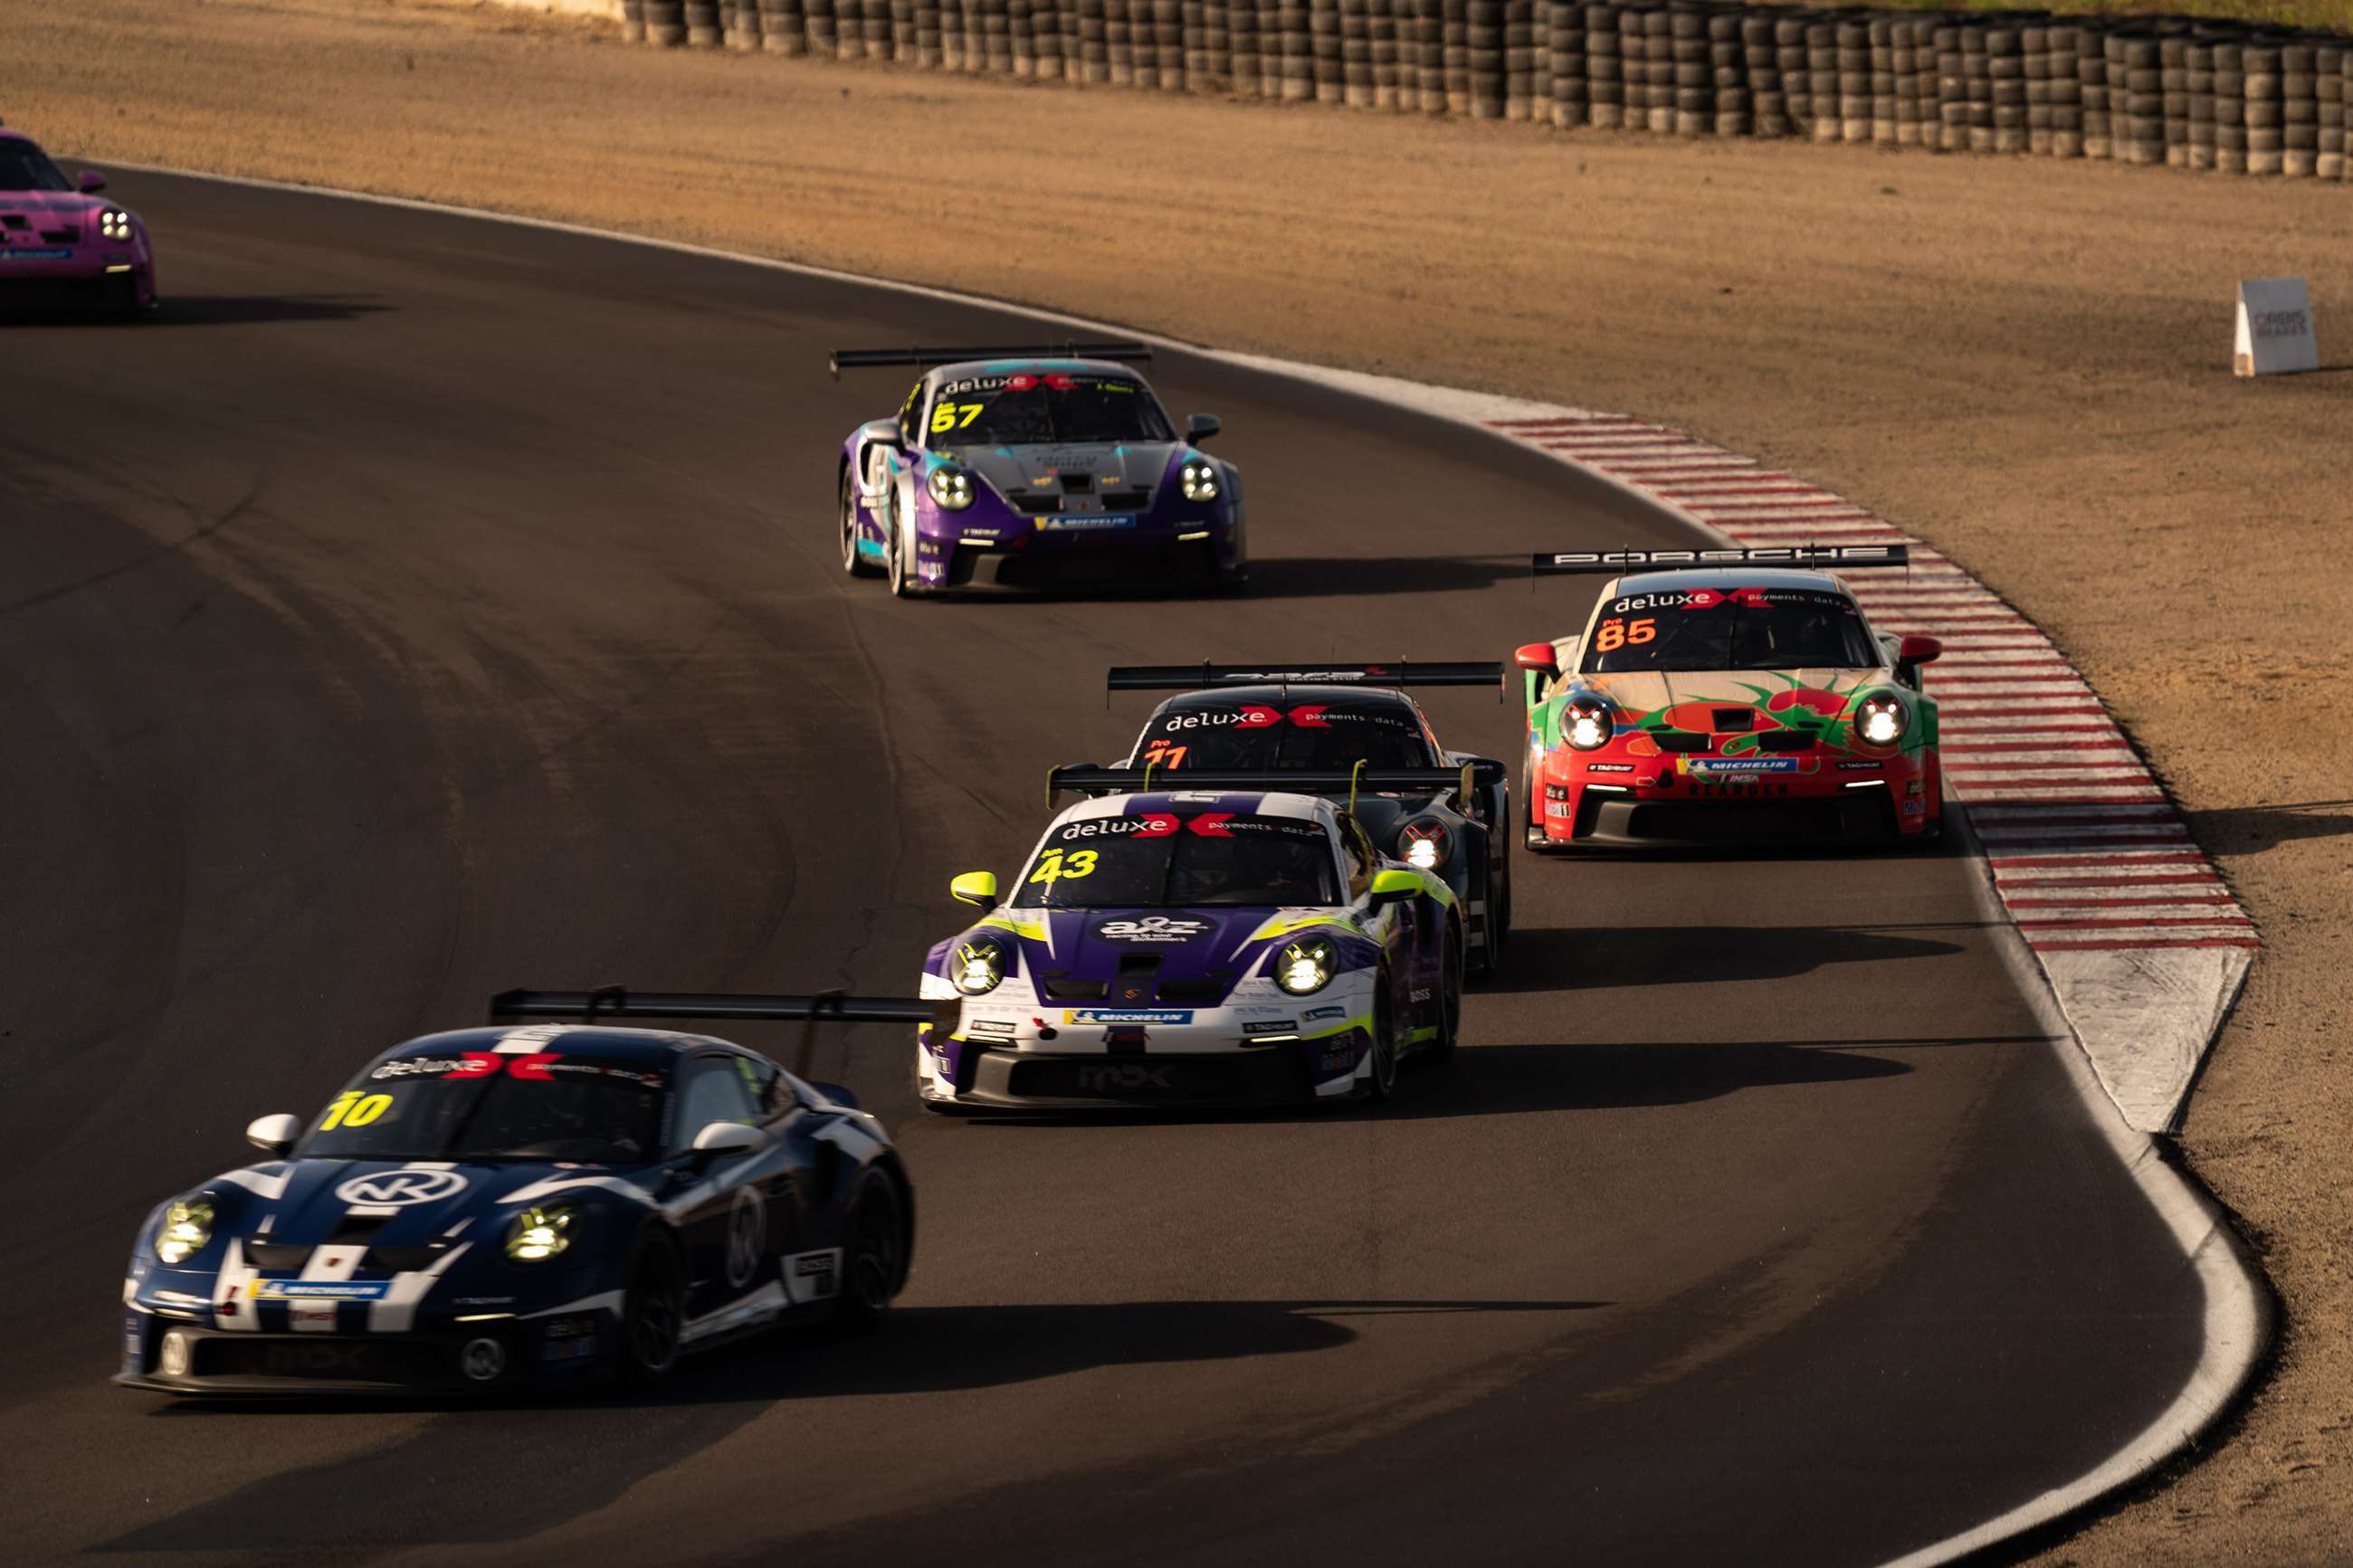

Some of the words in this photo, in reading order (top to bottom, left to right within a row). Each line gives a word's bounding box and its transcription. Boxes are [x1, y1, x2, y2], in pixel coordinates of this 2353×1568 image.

[945, 376, 1027, 394] deluxe
[1553, 546, 1890, 565] PORSCHE
[1615, 593, 1711, 613] deluxe
[1596, 618, 1657, 652] 85
[1166, 712, 1266, 732] deluxe
[1711, 761, 1788, 771] MICHELIN
[1062, 820, 1168, 841] deluxe
[1029, 850, 1099, 883] 43
[1098, 1013, 1184, 1022] MICHELIN
[371, 1057, 490, 1079] deluxe
[318, 1093, 395, 1131] 10
